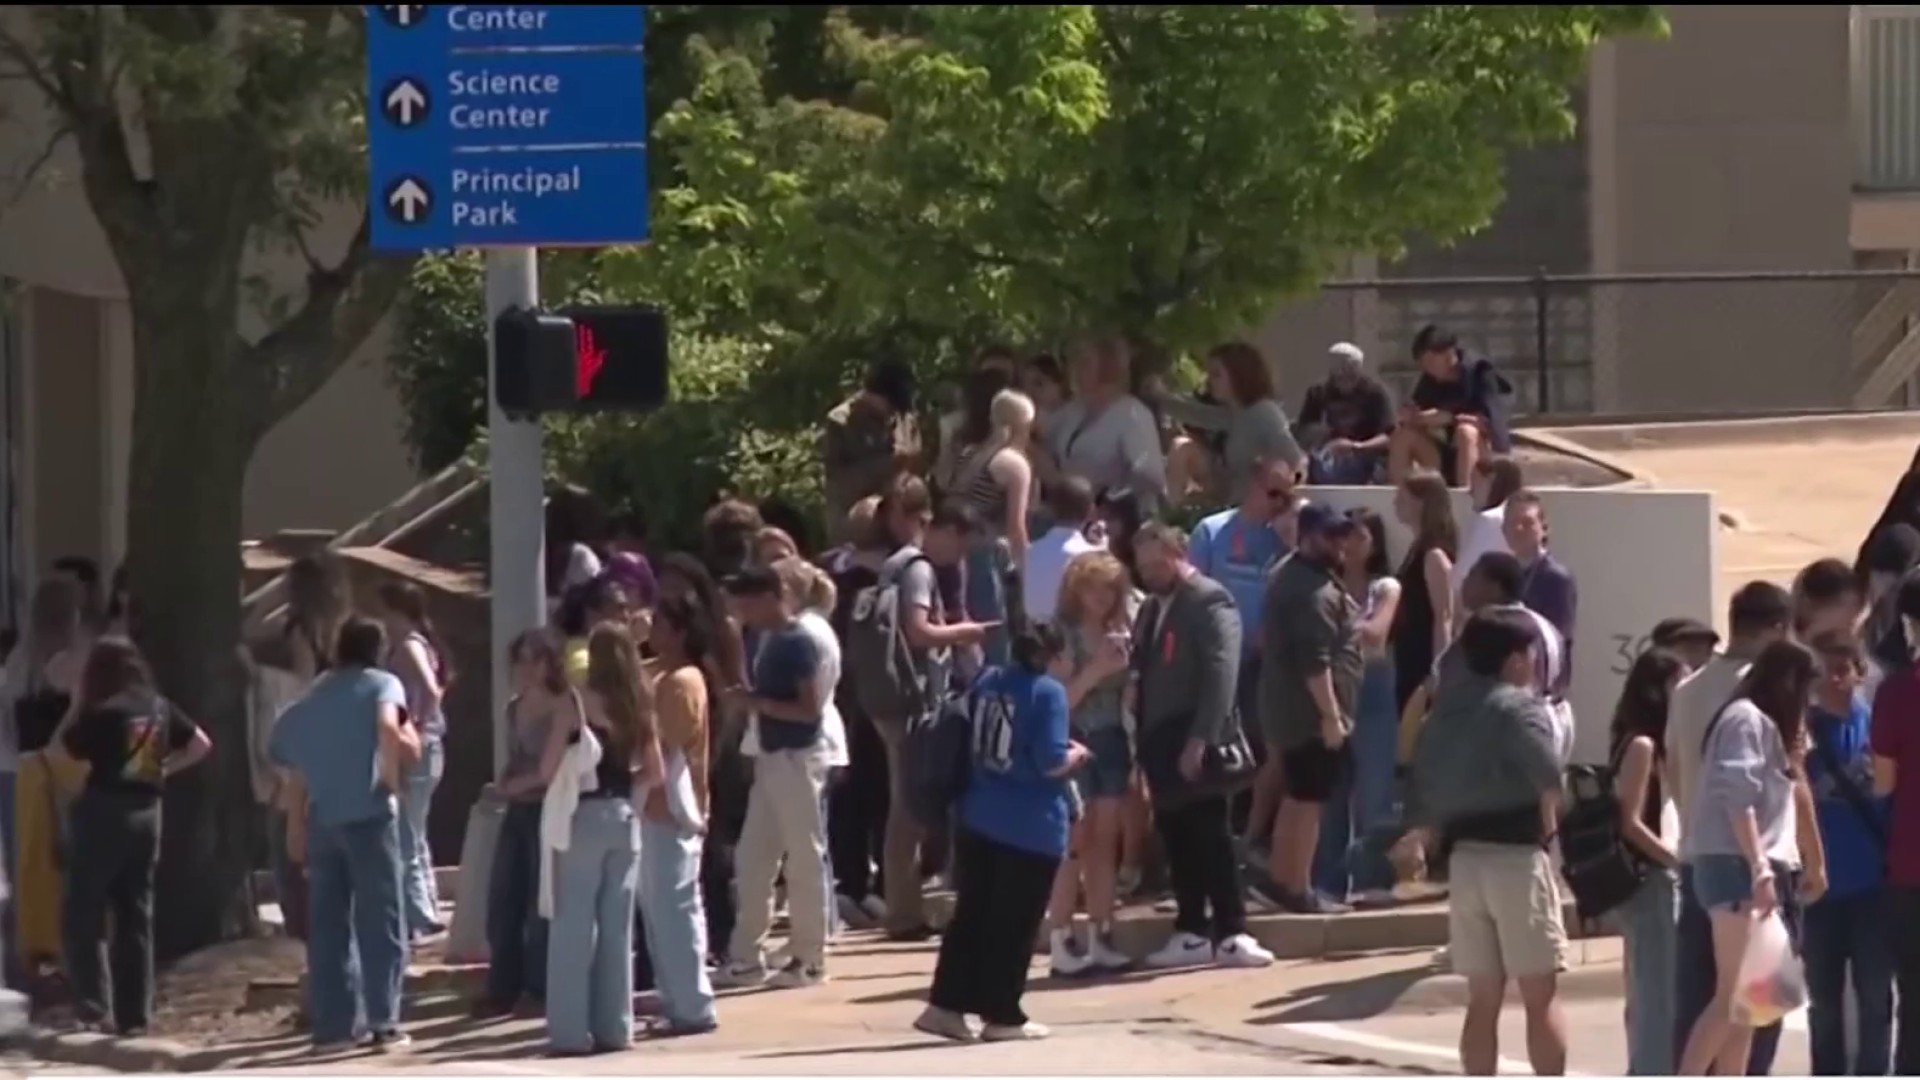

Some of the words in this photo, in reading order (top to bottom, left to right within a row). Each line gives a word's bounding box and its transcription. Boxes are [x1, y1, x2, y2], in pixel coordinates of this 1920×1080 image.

[448, 6, 546, 29] Center
[449, 70, 559, 95] Science
[450, 105, 548, 128] Center
[452, 166, 580, 197] Principal
[452, 201, 517, 226] Park
